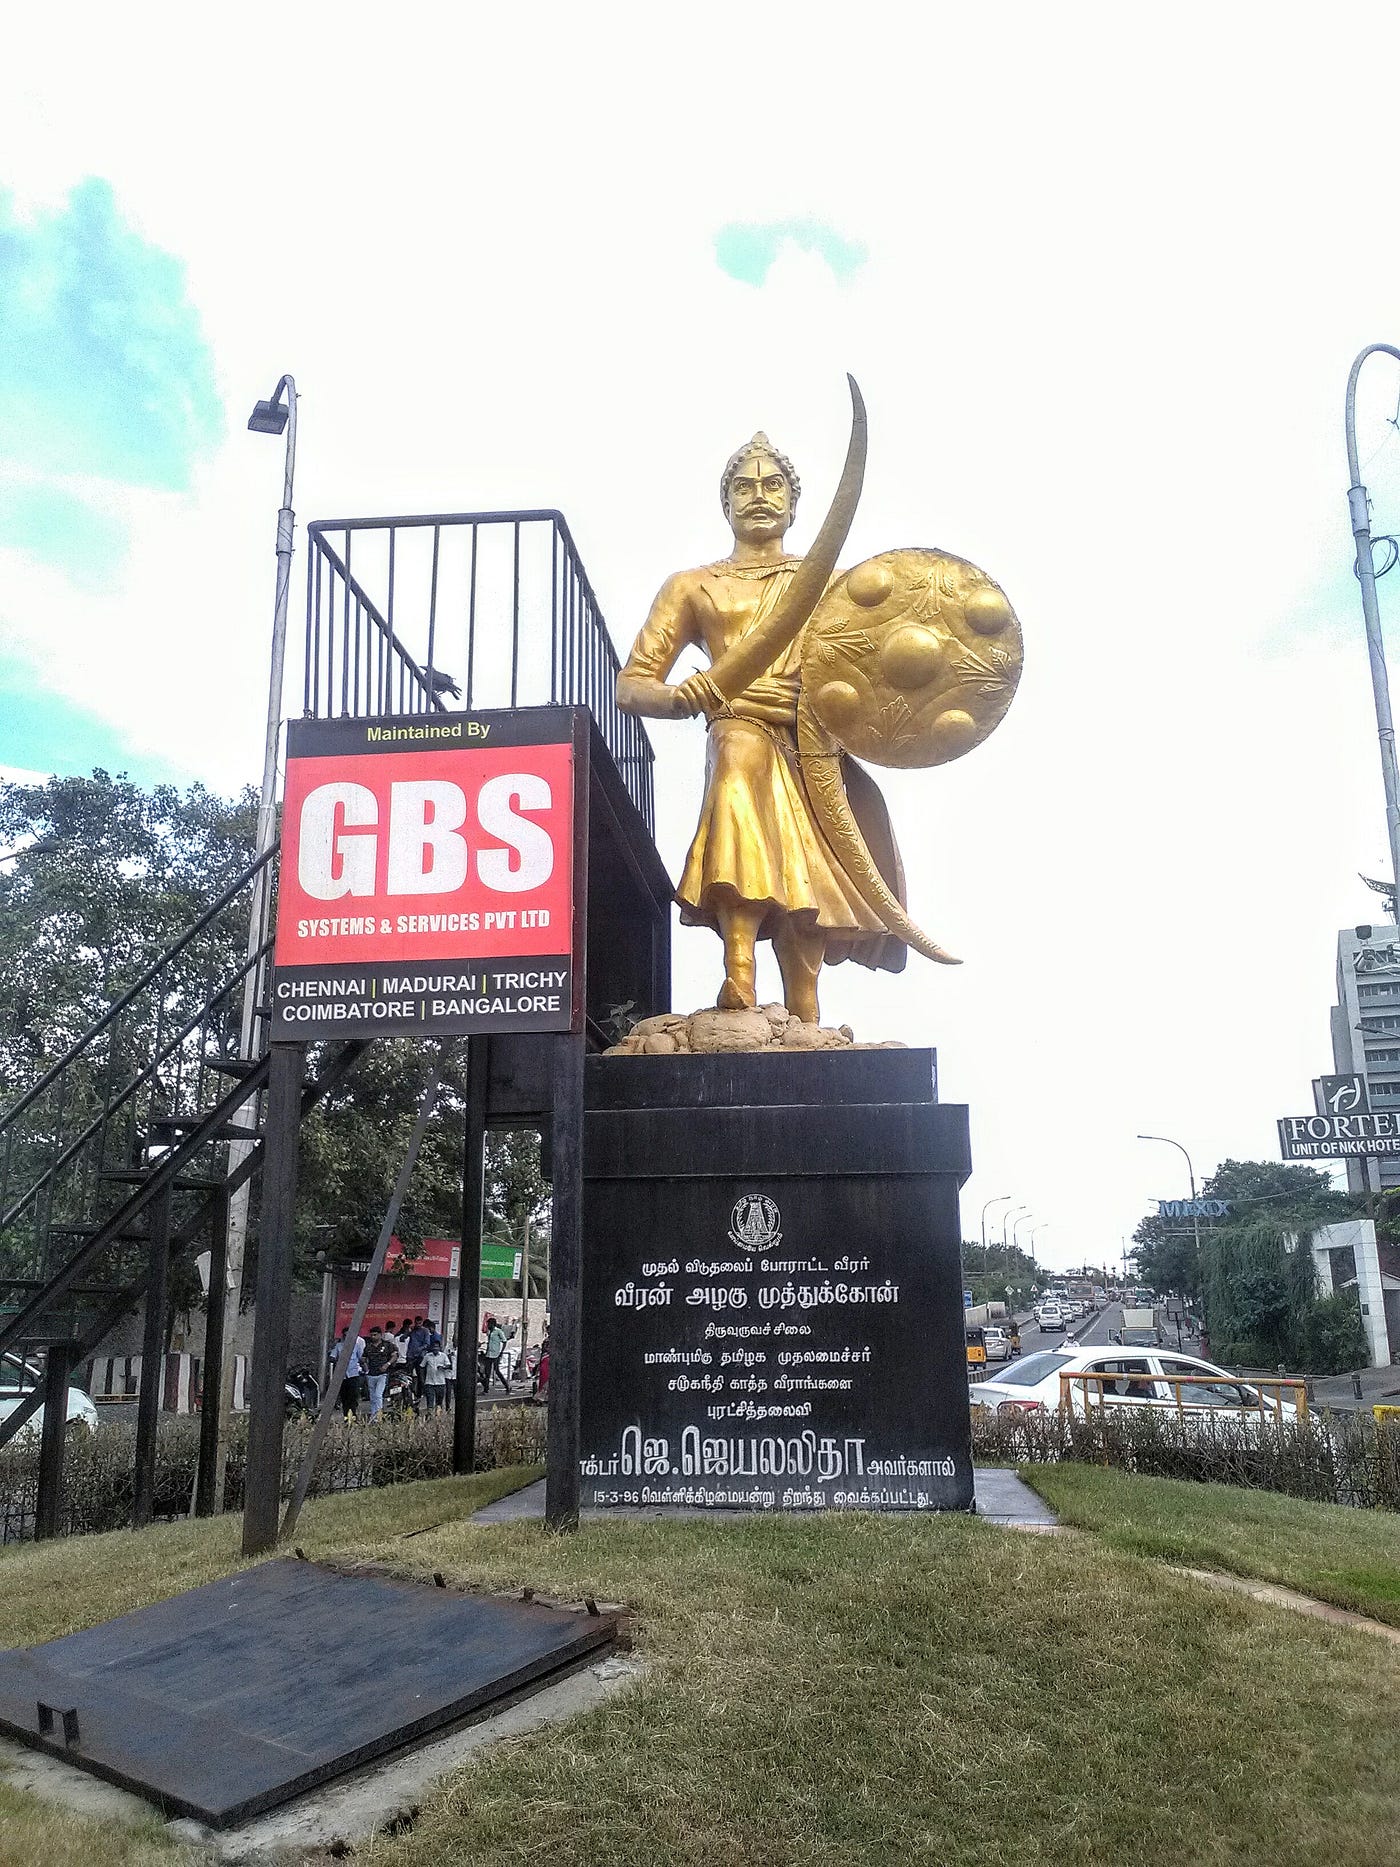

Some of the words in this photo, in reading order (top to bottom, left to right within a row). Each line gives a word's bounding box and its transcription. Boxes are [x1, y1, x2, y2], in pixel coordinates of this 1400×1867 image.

[367, 727, 462, 742] Maintained
[467, 721, 490, 739] By
[297, 773, 554, 900] GBS
[297, 916, 376, 938] SYSTEMS
[379, 918, 393, 934] &
[397, 912, 480, 933] SERVICES
[484, 911, 516, 930] PVT
[521, 909, 550, 928] LTD
[277, 979, 366, 999] CHENNAI
[383, 975, 477, 994] MADURAI
[492, 971, 568, 990] TRICHY
[282, 1001, 415, 1022] COIMBATORE
[432, 995, 561, 1017] BANGALORE
[1291, 1142, 1319, 1156] UNIT
[1321, 1142, 1338, 1154] OF
[1339, 1140, 1366, 1154] NKK
[642, 1258, 680, 1277] முதல்
[685, 1257, 753, 1278] விடுதலைப்
[760, 1256, 829, 1274] போராட்ட
[834, 1255, 871, 1274] வீரர்
[614, 1281, 674, 1311] வீரன்
[685, 1287, 748, 1311] அழகு
[758, 1279, 899, 1310] முத்துக்கோன்
[644, 1347, 713, 1366] மாண்புமிகு
[720, 1347, 767, 1367] தமிழக
[777, 1346, 872, 1366] முதலமைச்சர்
[667, 1374, 725, 1393] சமூகநீதி
[729, 1373, 768, 1393] காத்த
[773, 1374, 853, 1392] வீராங்கனை
[707, 1400, 812, 1420] புரட்சித்தலைவி
[866, 1454, 957, 1477] அவர்களால்
[593, 1489, 639, 1504] 15-3-96
[641, 1485, 776, 1508] வெள்ளிக்கிழமையன்று
[782, 1485, 826, 1506] திறந்து
